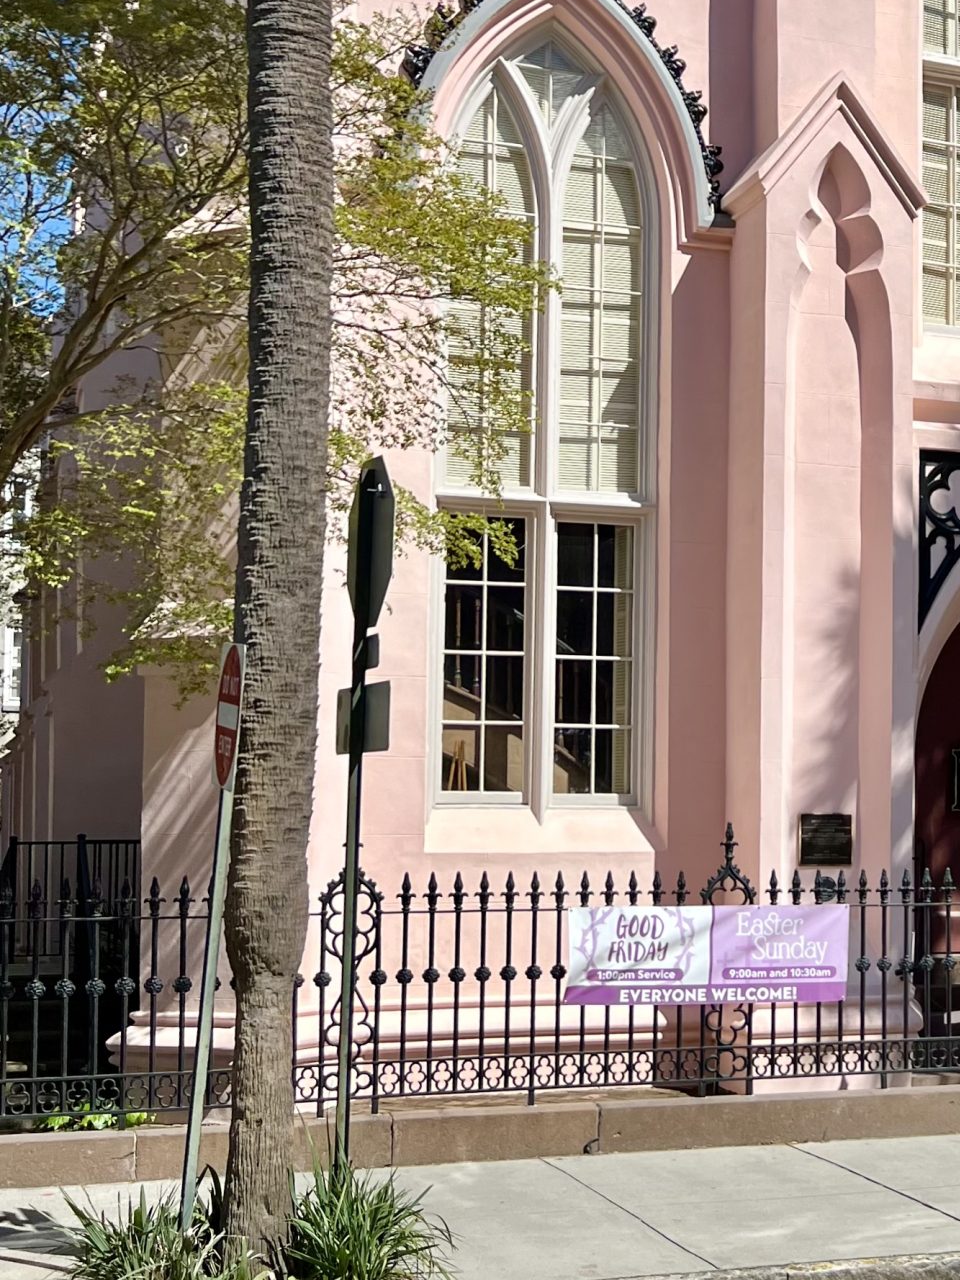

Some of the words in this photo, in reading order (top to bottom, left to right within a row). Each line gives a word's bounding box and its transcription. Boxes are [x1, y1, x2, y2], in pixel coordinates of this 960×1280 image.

[616, 913, 665, 940] GOOD
[736, 911, 804, 936] Easter
[607, 940, 669, 963] FRIDAY
[751, 935, 828, 965] Sunday
[597, 970, 636, 982] 1:00pm
[637, 970, 676, 980] Service
[729, 968, 767, 978] 9:00am
[769, 968, 788, 978] and
[790, 967, 831, 977] 10:30am
[619, 988, 707, 1003] EVERYONE
[710, 986, 798, 1002] WELCOME!
